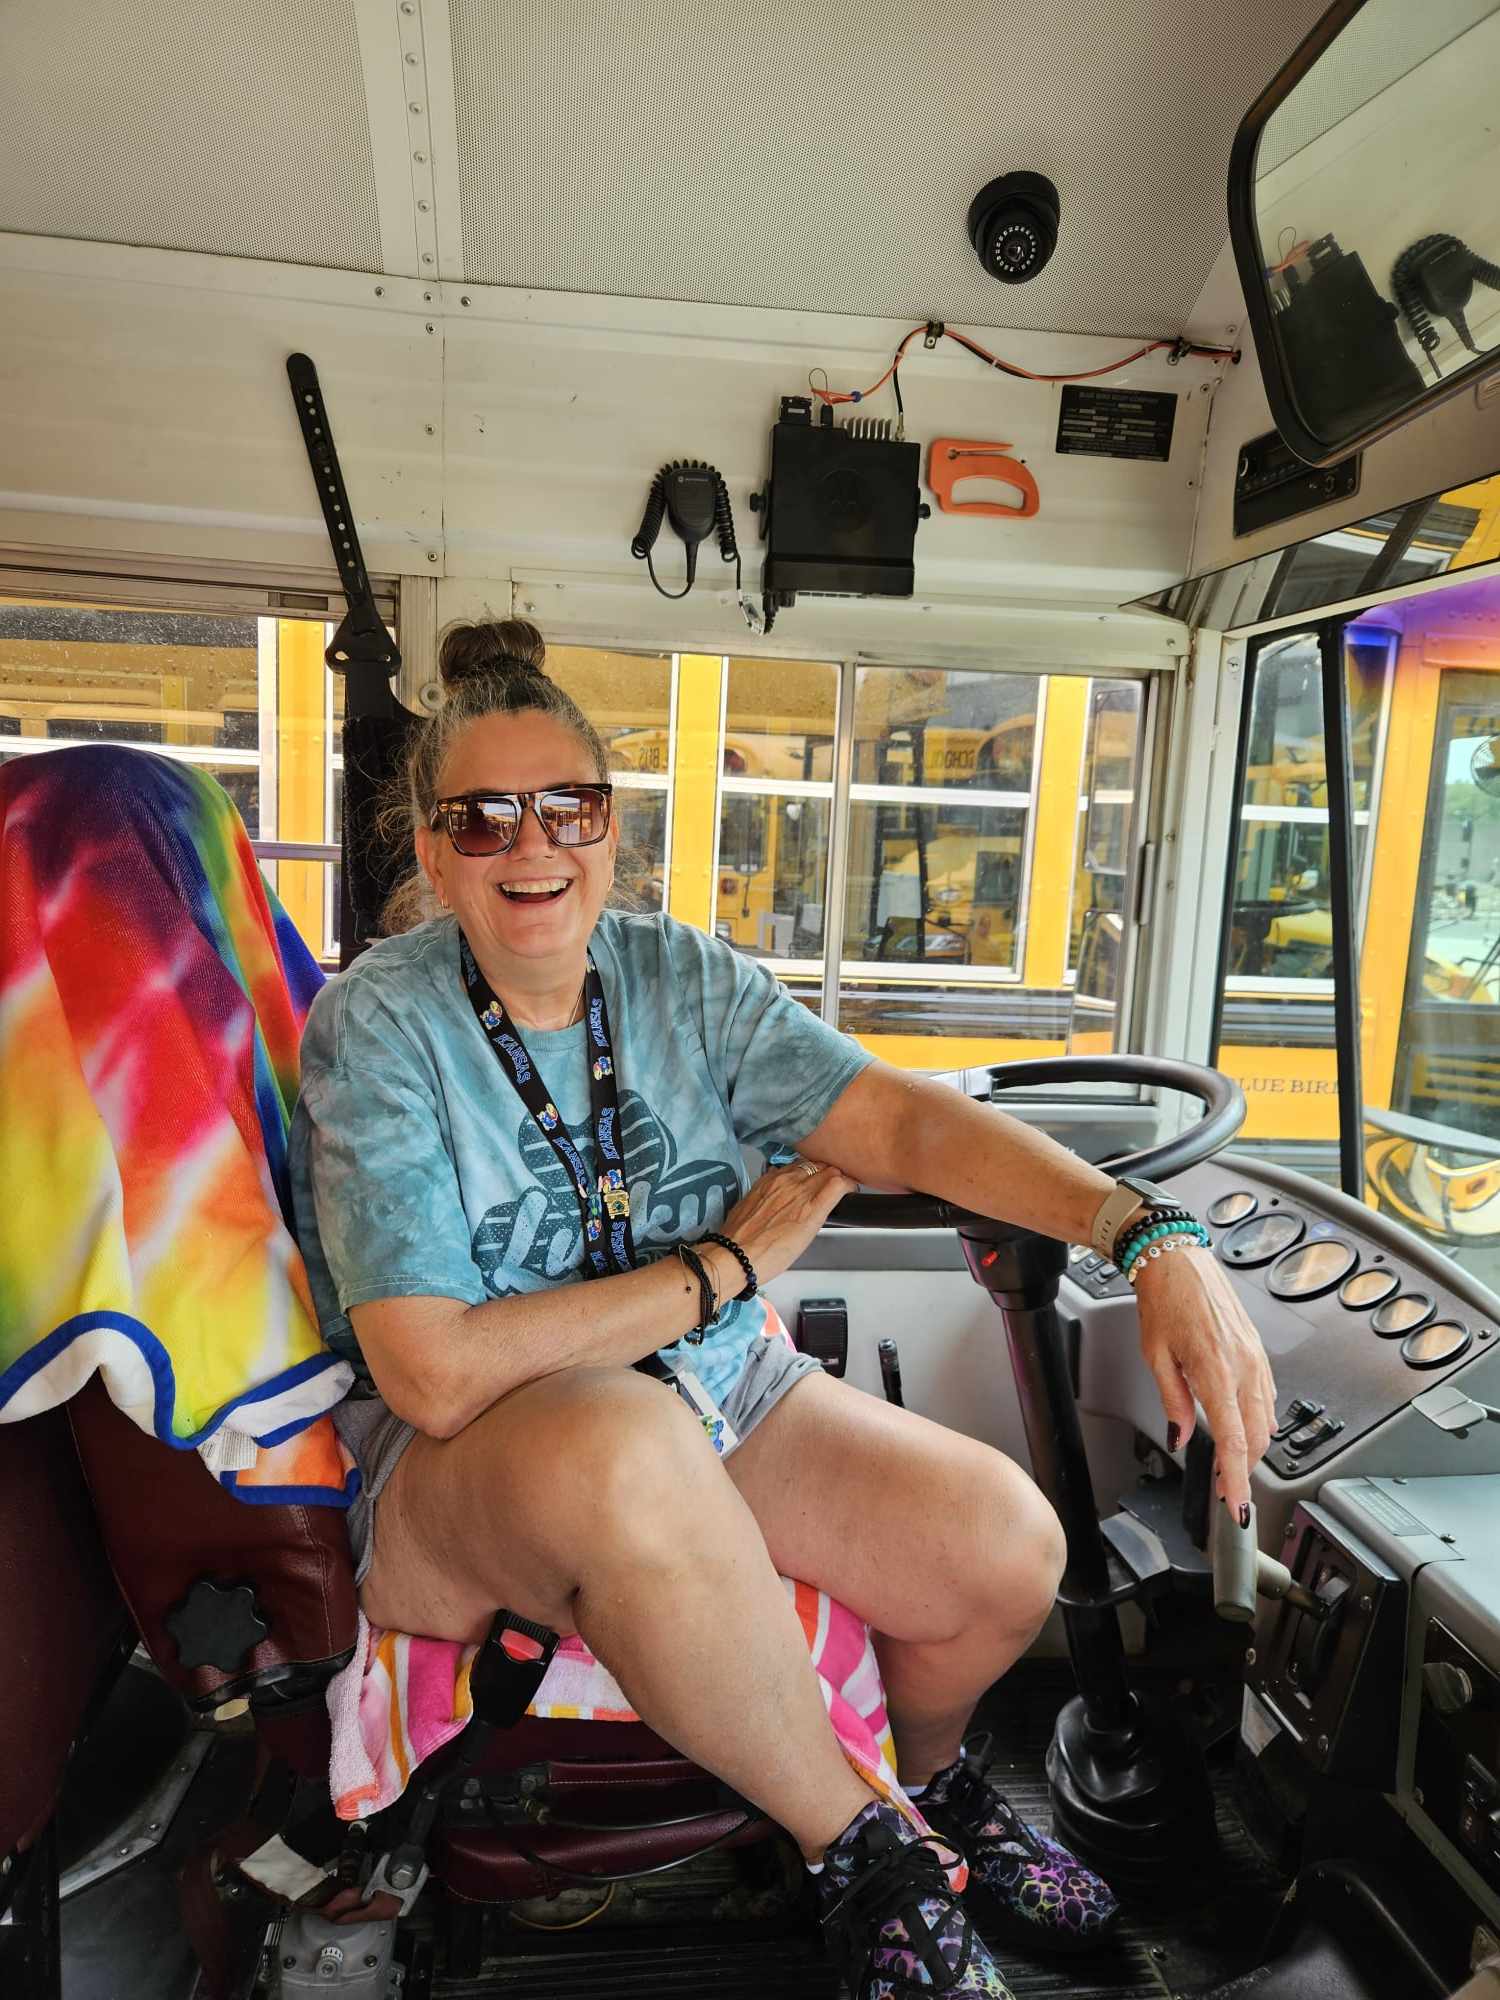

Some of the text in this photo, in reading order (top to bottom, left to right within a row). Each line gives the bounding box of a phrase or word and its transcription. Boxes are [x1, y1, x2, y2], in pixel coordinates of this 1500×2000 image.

[590, 997, 610, 1047] KANSAS
[492, 1033, 532, 1085] KANSAS
[1240, 1077, 1285, 1092] LUE
[599, 1107, 621, 1160] KANSAS
